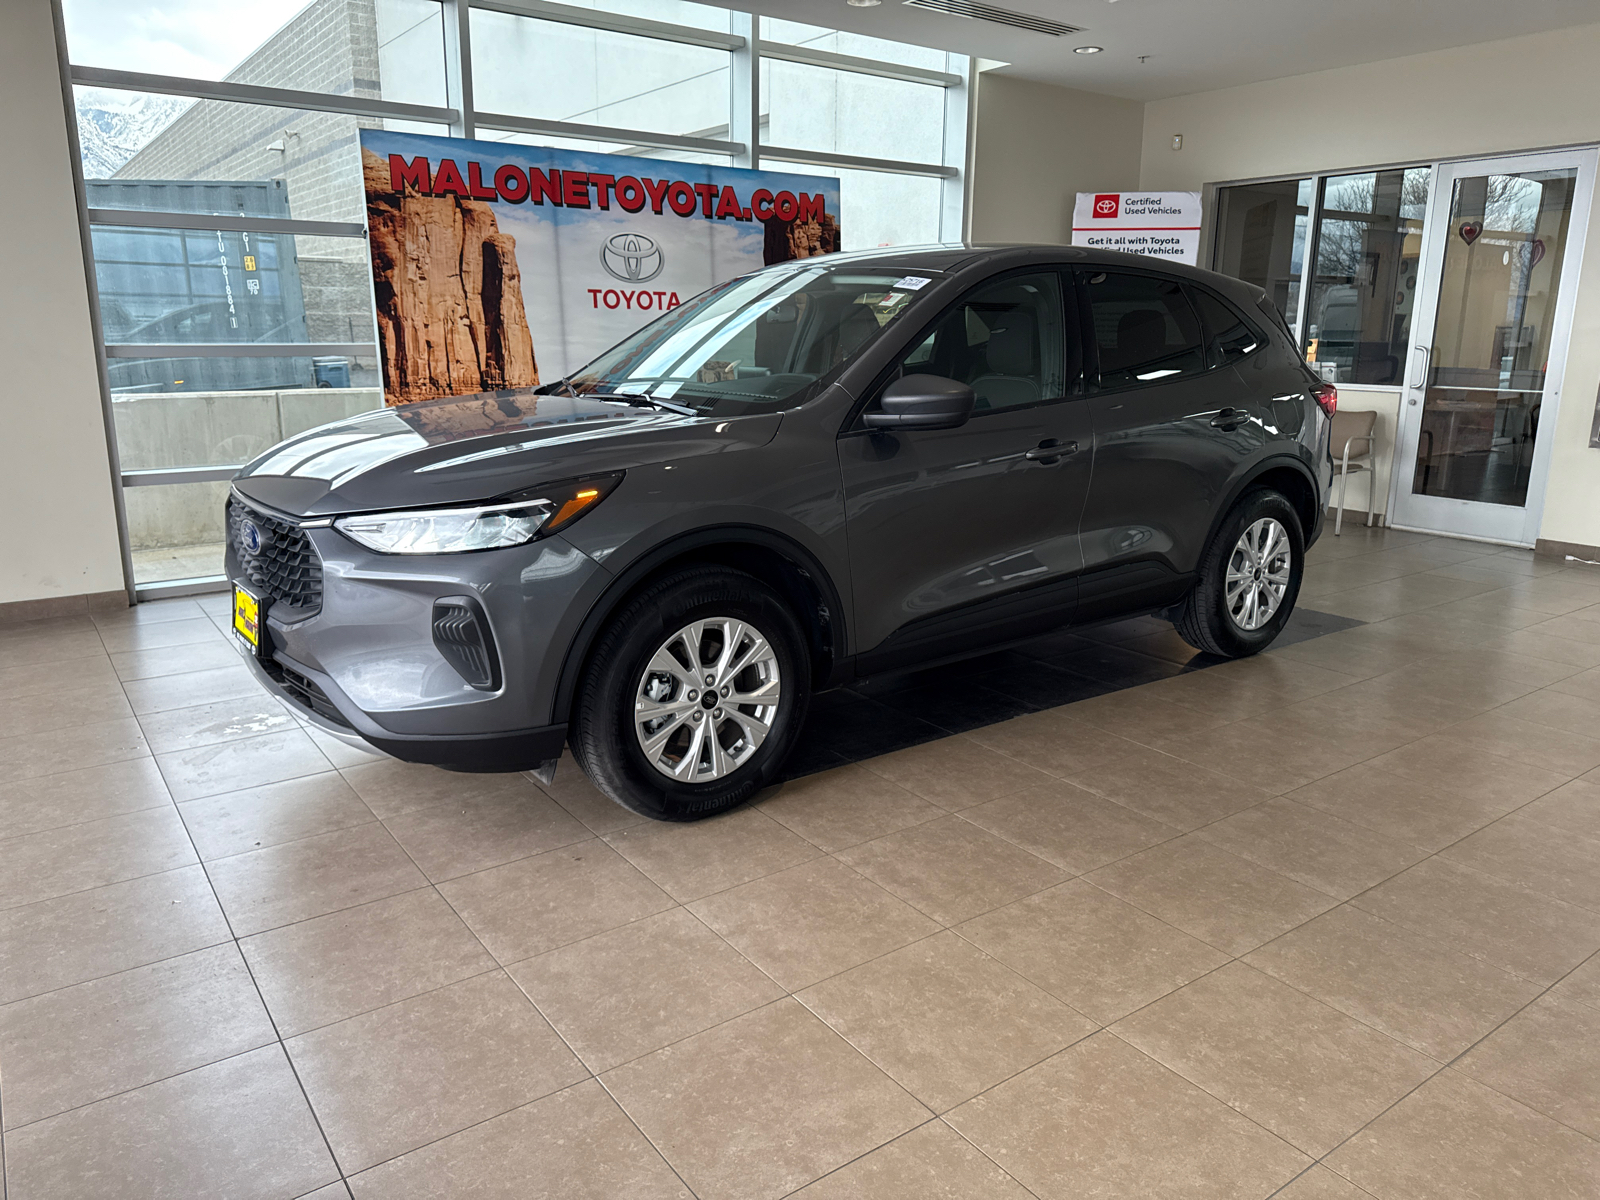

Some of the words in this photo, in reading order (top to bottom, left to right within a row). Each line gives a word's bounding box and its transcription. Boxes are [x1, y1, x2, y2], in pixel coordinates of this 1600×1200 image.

[388, 153, 826, 224] MALONETOYOTA.COM
[1125, 198, 1162, 206] Certified
[1124, 207, 1145, 215] Used
[1147, 207, 1182, 215] Vehicles
[1087, 237, 1104, 245] Get
[1105, 236, 1112, 245] it
[1114, 236, 1126, 245] all
[1127, 236, 1148, 245] with
[1149, 237, 1180, 246] Toyota
[1122, 247, 1145, 255] Used
[1147, 246, 1184, 255] Vehicles
[587, 288, 681, 311] TOYOTA
